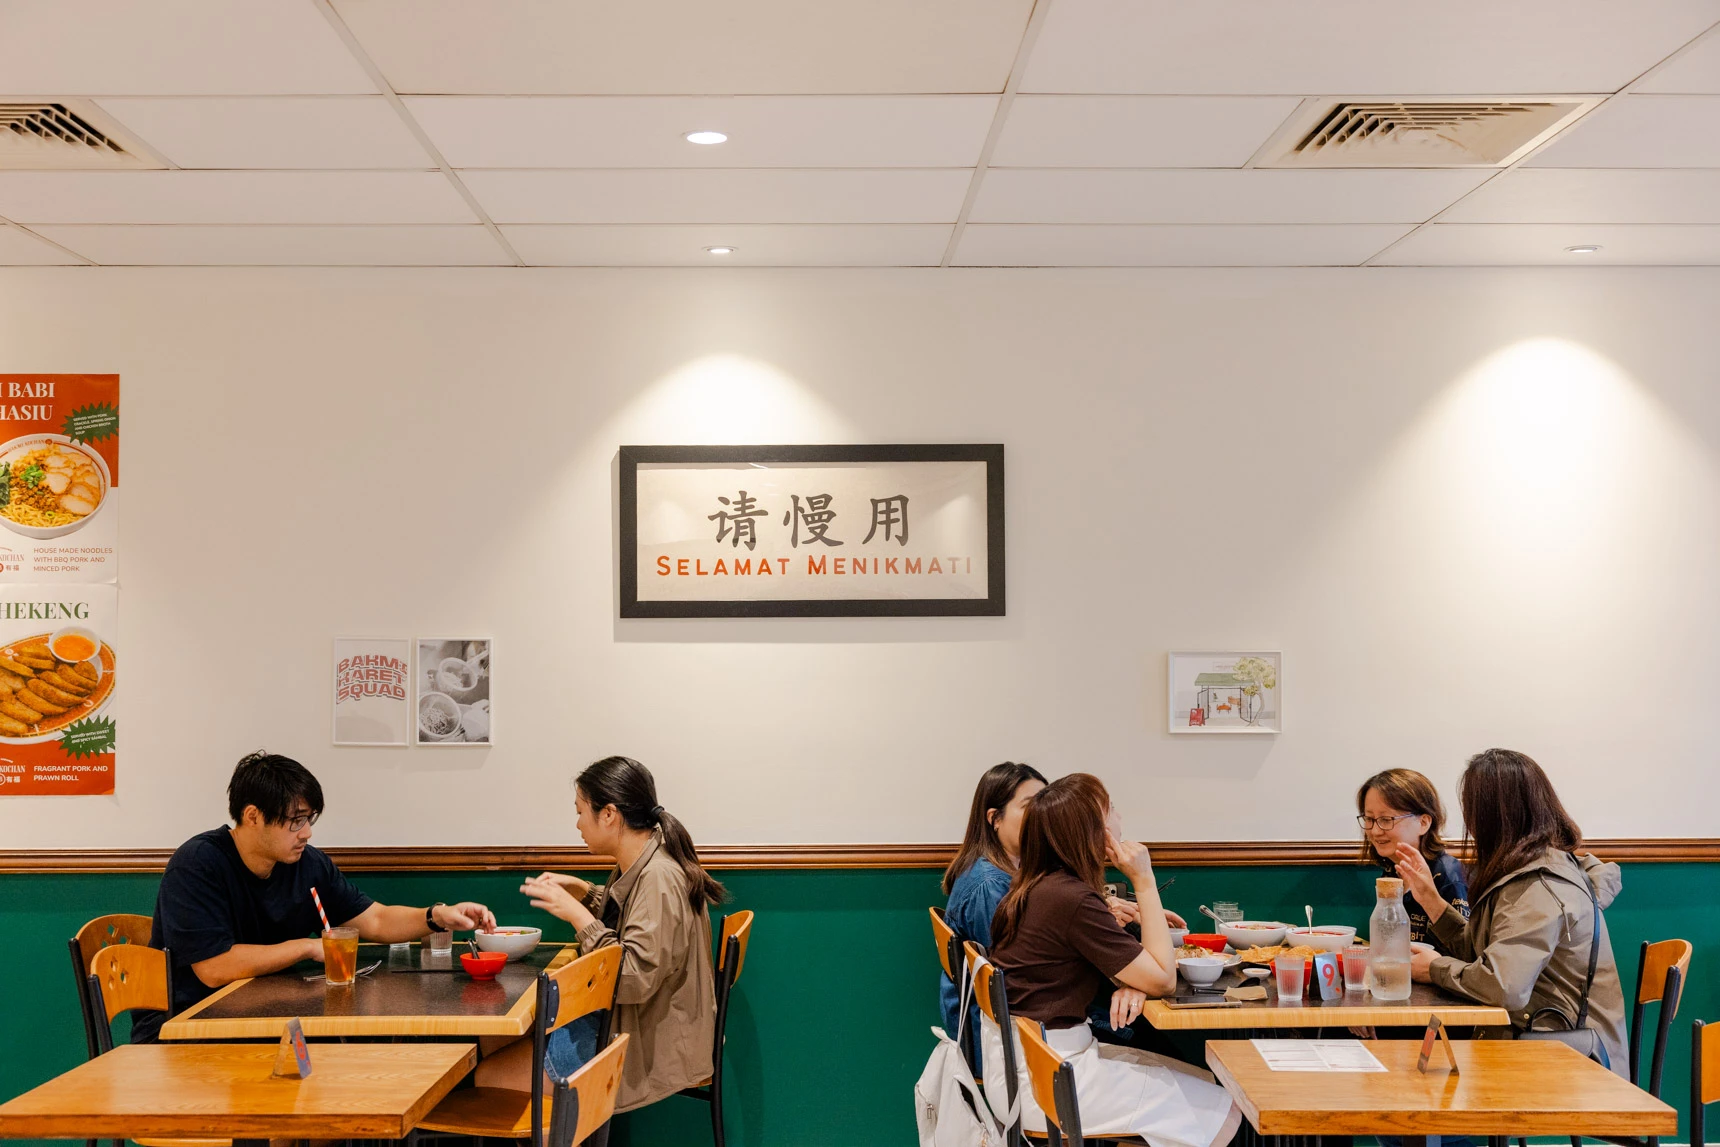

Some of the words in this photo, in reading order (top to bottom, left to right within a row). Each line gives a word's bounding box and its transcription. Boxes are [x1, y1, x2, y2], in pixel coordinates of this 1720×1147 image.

[8, 382, 55, 398] BABI
[708, 490, 910, 551] 请慢用
[54, 556, 68, 564] BBQ
[656, 555, 790, 576] SELAMAT
[808, 554, 972, 575] MENIKMATI
[338, 654, 408, 675] BAKMI
[338, 668, 404, 688] KARET
[338, 682, 406, 701] SQUAD
[1322, 963, 1335, 987] 9
